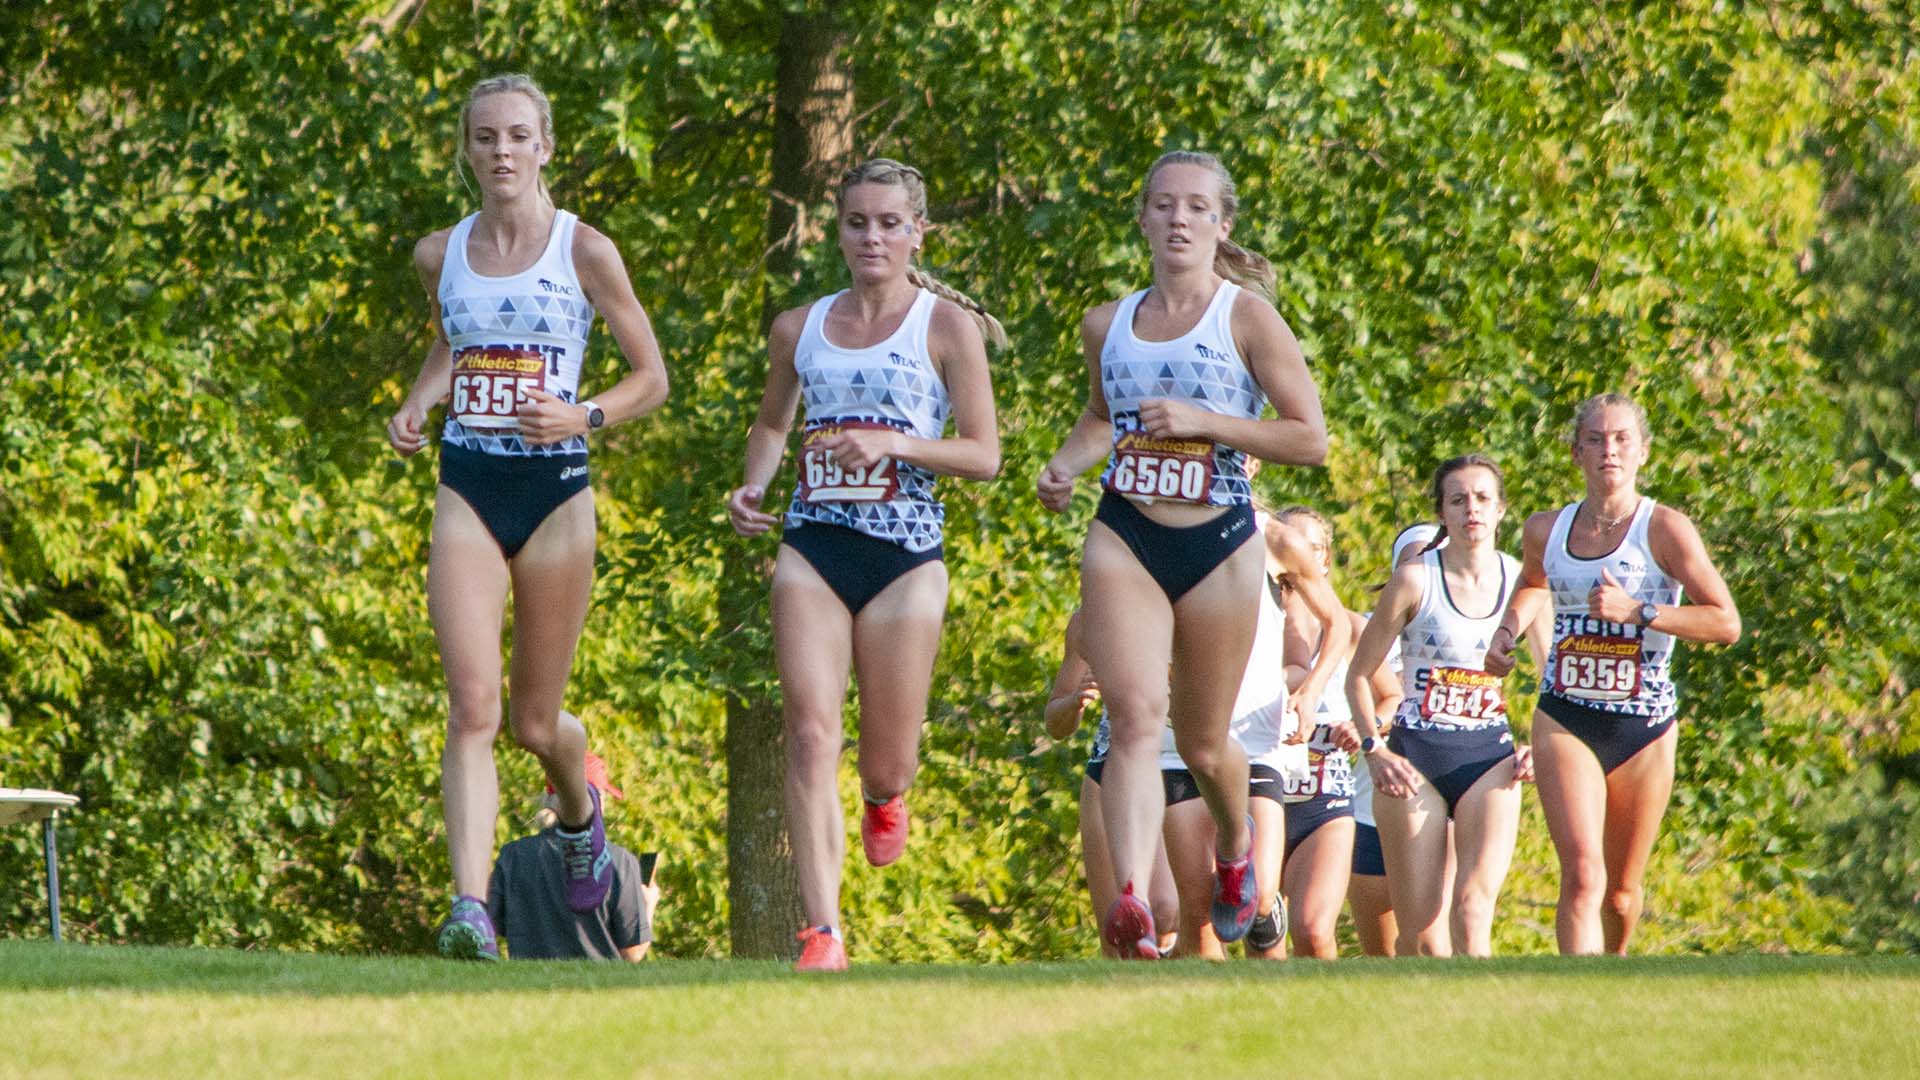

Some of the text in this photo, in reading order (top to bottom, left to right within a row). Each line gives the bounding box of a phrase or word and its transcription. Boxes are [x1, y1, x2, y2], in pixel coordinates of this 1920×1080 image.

[542, 281, 573, 296] WIAC
[455, 353, 515, 370] Athletic
[890, 355, 921, 369] WIAC
[1198, 347, 1230, 362] WIAC
[1114, 454, 1205, 500] 6560
[1559, 636, 1615, 654] Athletic
[1560, 655, 1636, 691] 6359
[1428, 684, 1501, 718] 6542
